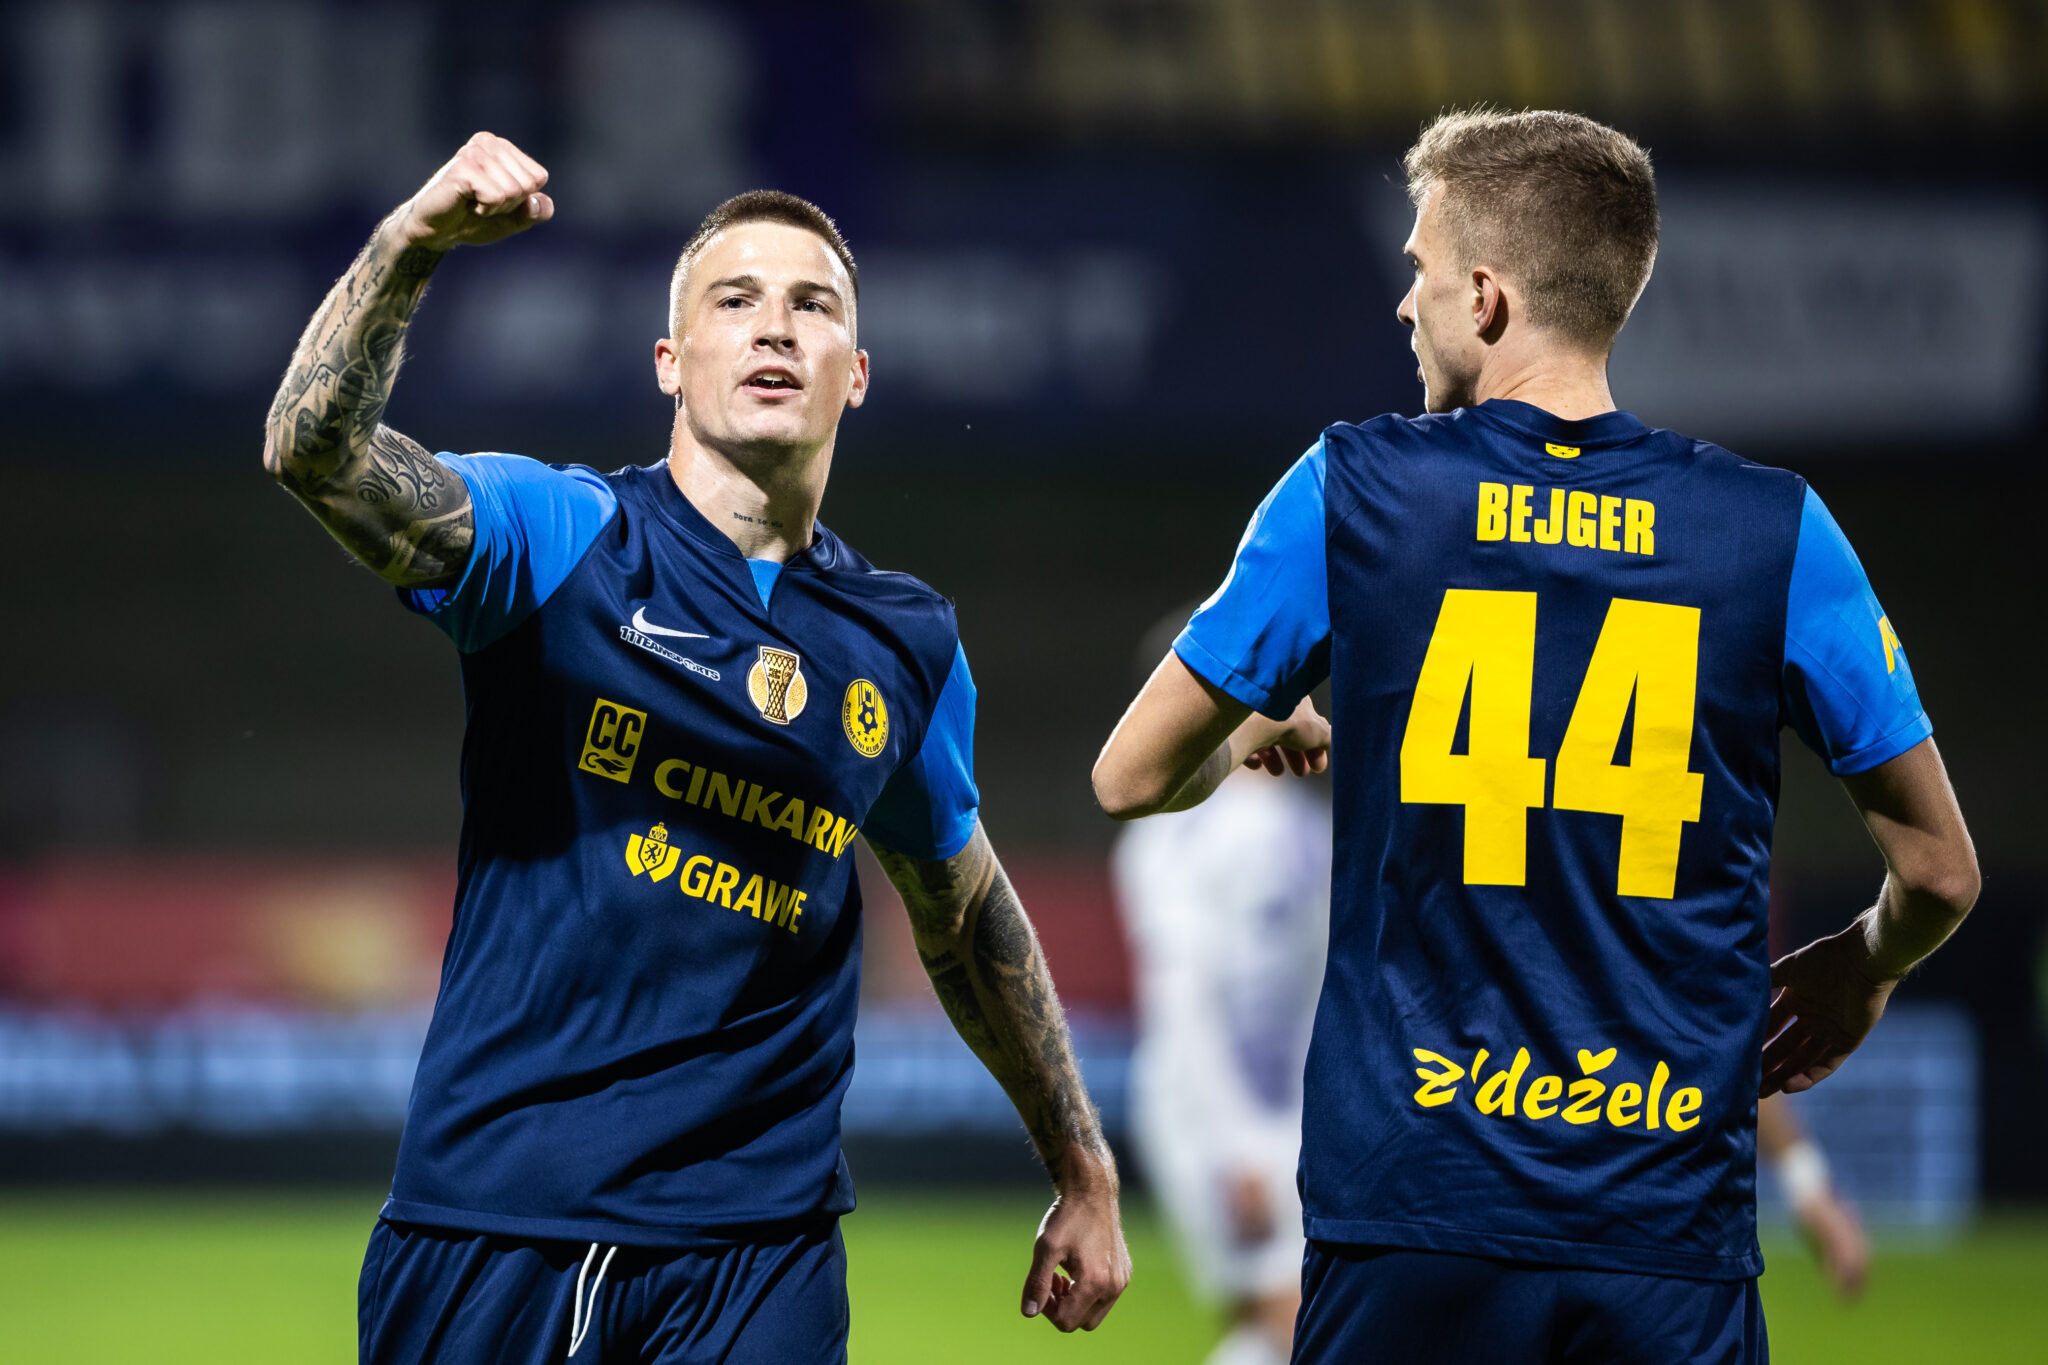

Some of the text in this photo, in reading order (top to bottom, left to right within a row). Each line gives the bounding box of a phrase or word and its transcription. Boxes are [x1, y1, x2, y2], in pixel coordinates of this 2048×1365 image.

[1476, 482, 1655, 556] BEJGER
[1400, 589, 1704, 899] 44
[680, 855, 807, 934] GRAWE
